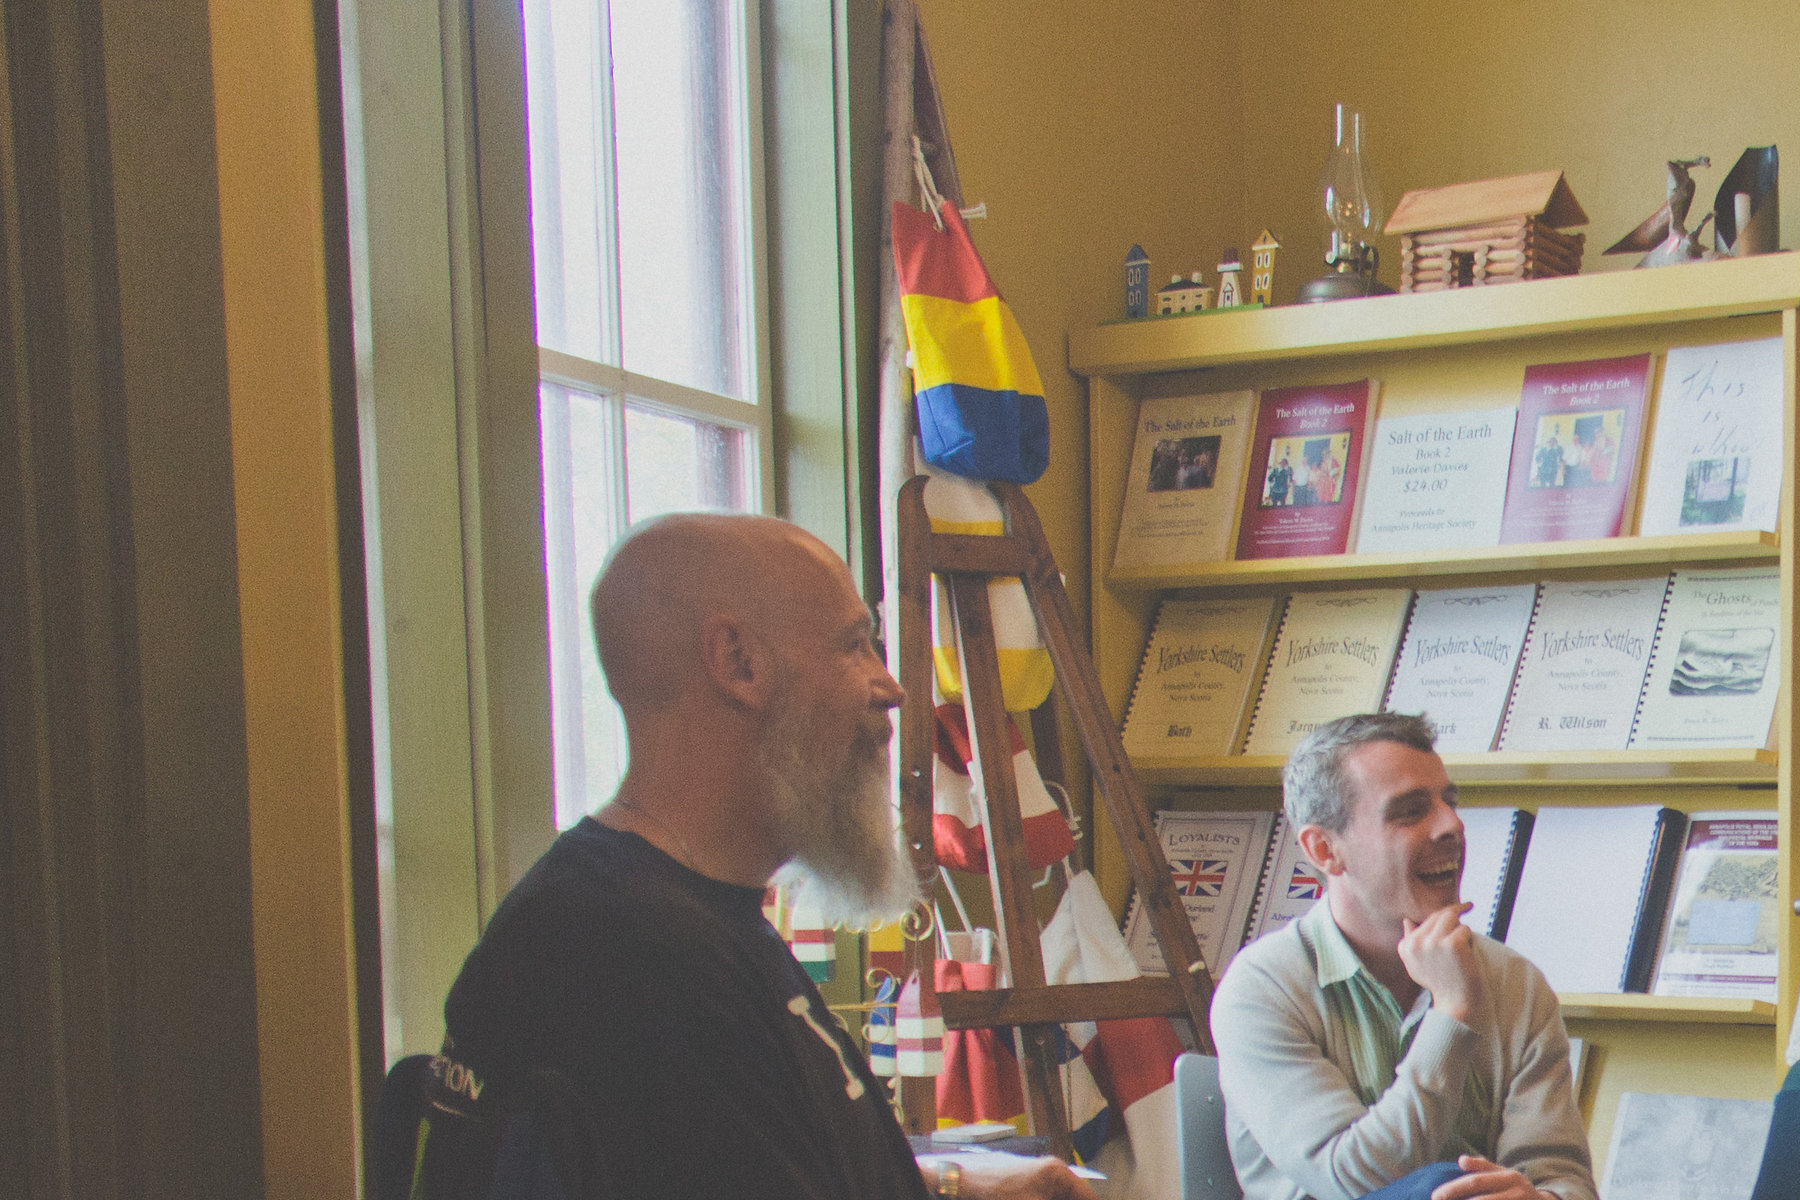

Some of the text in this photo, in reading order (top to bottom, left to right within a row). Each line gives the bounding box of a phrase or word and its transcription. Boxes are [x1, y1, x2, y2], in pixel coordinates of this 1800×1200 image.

[1560, 383, 1578, 395] Salt
[1606, 378, 1631, 391] Earth
[1276, 407, 1292, 419] The
[1292, 406, 1306, 418] Salt
[1319, 405, 1332, 416] the
[1333, 402, 1355, 415] Earth
[1165, 417, 1183, 432] Salt
[1212, 414, 1237, 428] Earth
[1387, 423, 1493, 446] Salt of the Earth
[1415, 448, 1440, 461] Book
[1391, 461, 1470, 476] Valerie Davies
[1402, 478, 1449, 494] $24.00
[1706, 591, 1752, 606] Ghosts
[1287, 636, 1378, 668] Yorkshire Settlers
[1414, 634, 1512, 668] Yorkshire Settlers
[1541, 628, 1645, 661] Yorkshire Settlers
[1157, 643, 1246, 675] Yorkshire Settlers
[1538, 715, 1607, 730] R. Wilson
[1168, 833, 1240, 846] LOYALISTS
